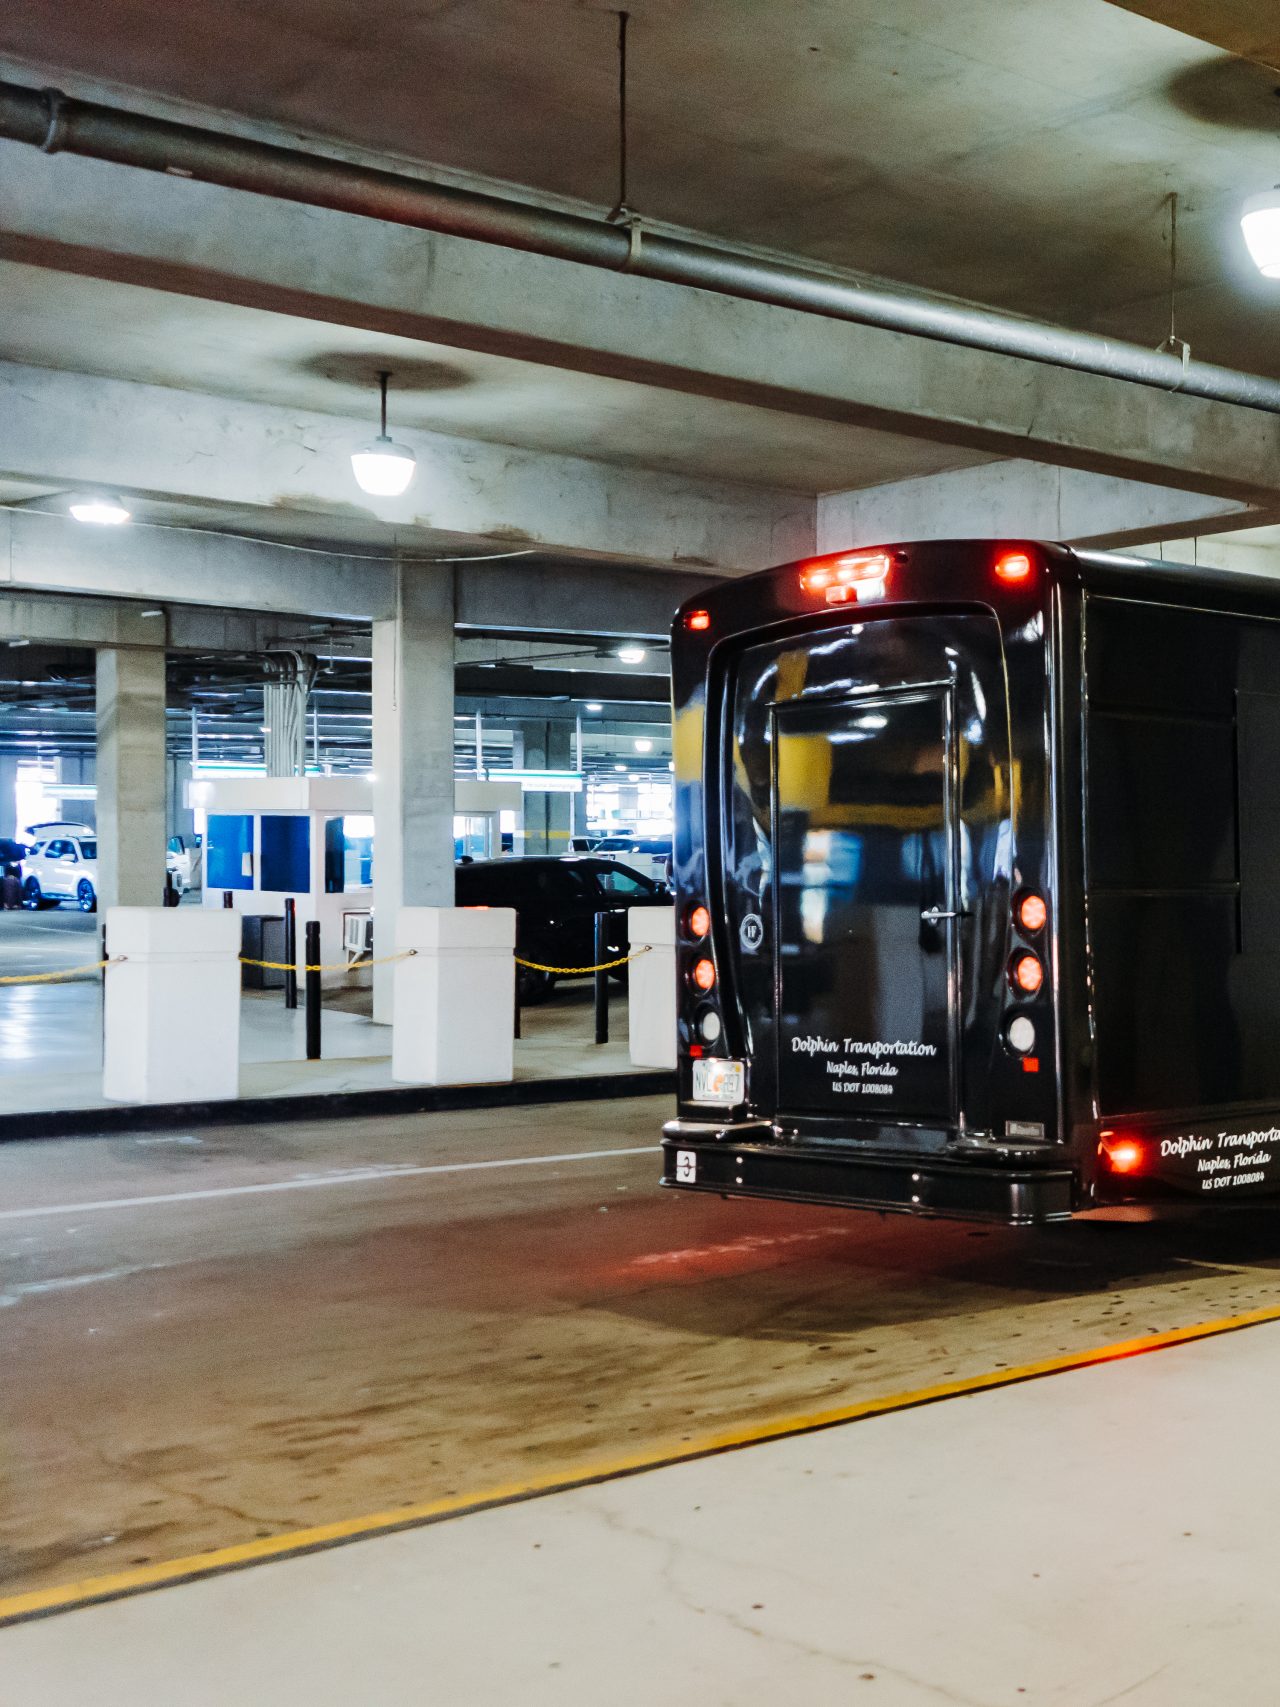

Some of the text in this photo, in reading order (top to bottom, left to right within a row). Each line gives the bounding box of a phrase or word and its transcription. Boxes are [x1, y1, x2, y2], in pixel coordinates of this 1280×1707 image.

[791, 1036, 937, 1059] Dolphin Transportation
[827, 1061, 899, 1077] Naples, Florida
[832, 1082, 894, 1094] US DOT 1008084
[1160, 1135, 1213, 1158] Dolphin
[1197, 1150, 1272, 1174] Naples, Florida
[1202, 1171, 1265, 1190] US DOT 1008084
